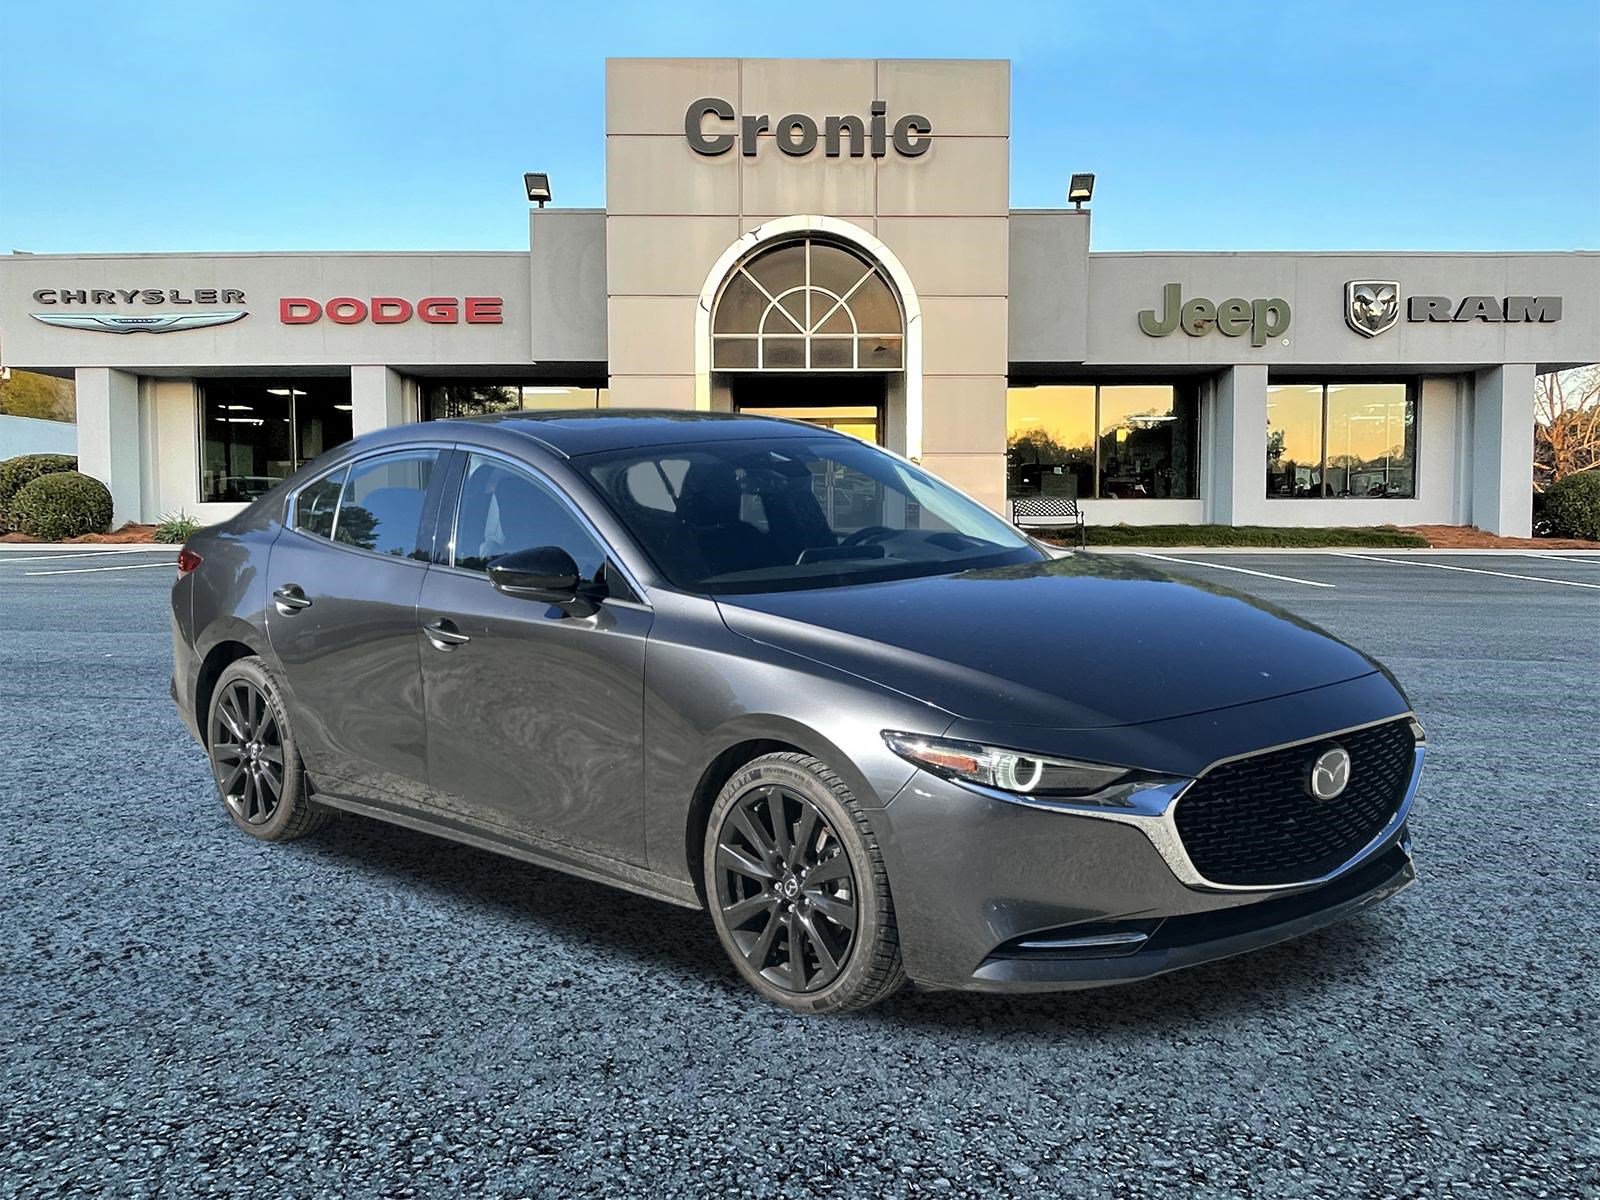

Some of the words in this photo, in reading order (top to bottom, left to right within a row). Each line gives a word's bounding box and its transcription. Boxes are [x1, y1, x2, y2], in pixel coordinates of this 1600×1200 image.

[685, 97, 932, 157] Cronic
[32, 288, 246, 305] CHRYSLER
[1407, 295, 1563, 323] RAM
[279, 297, 504, 325] DODGE
[1138, 283, 1292, 348] Jeep
